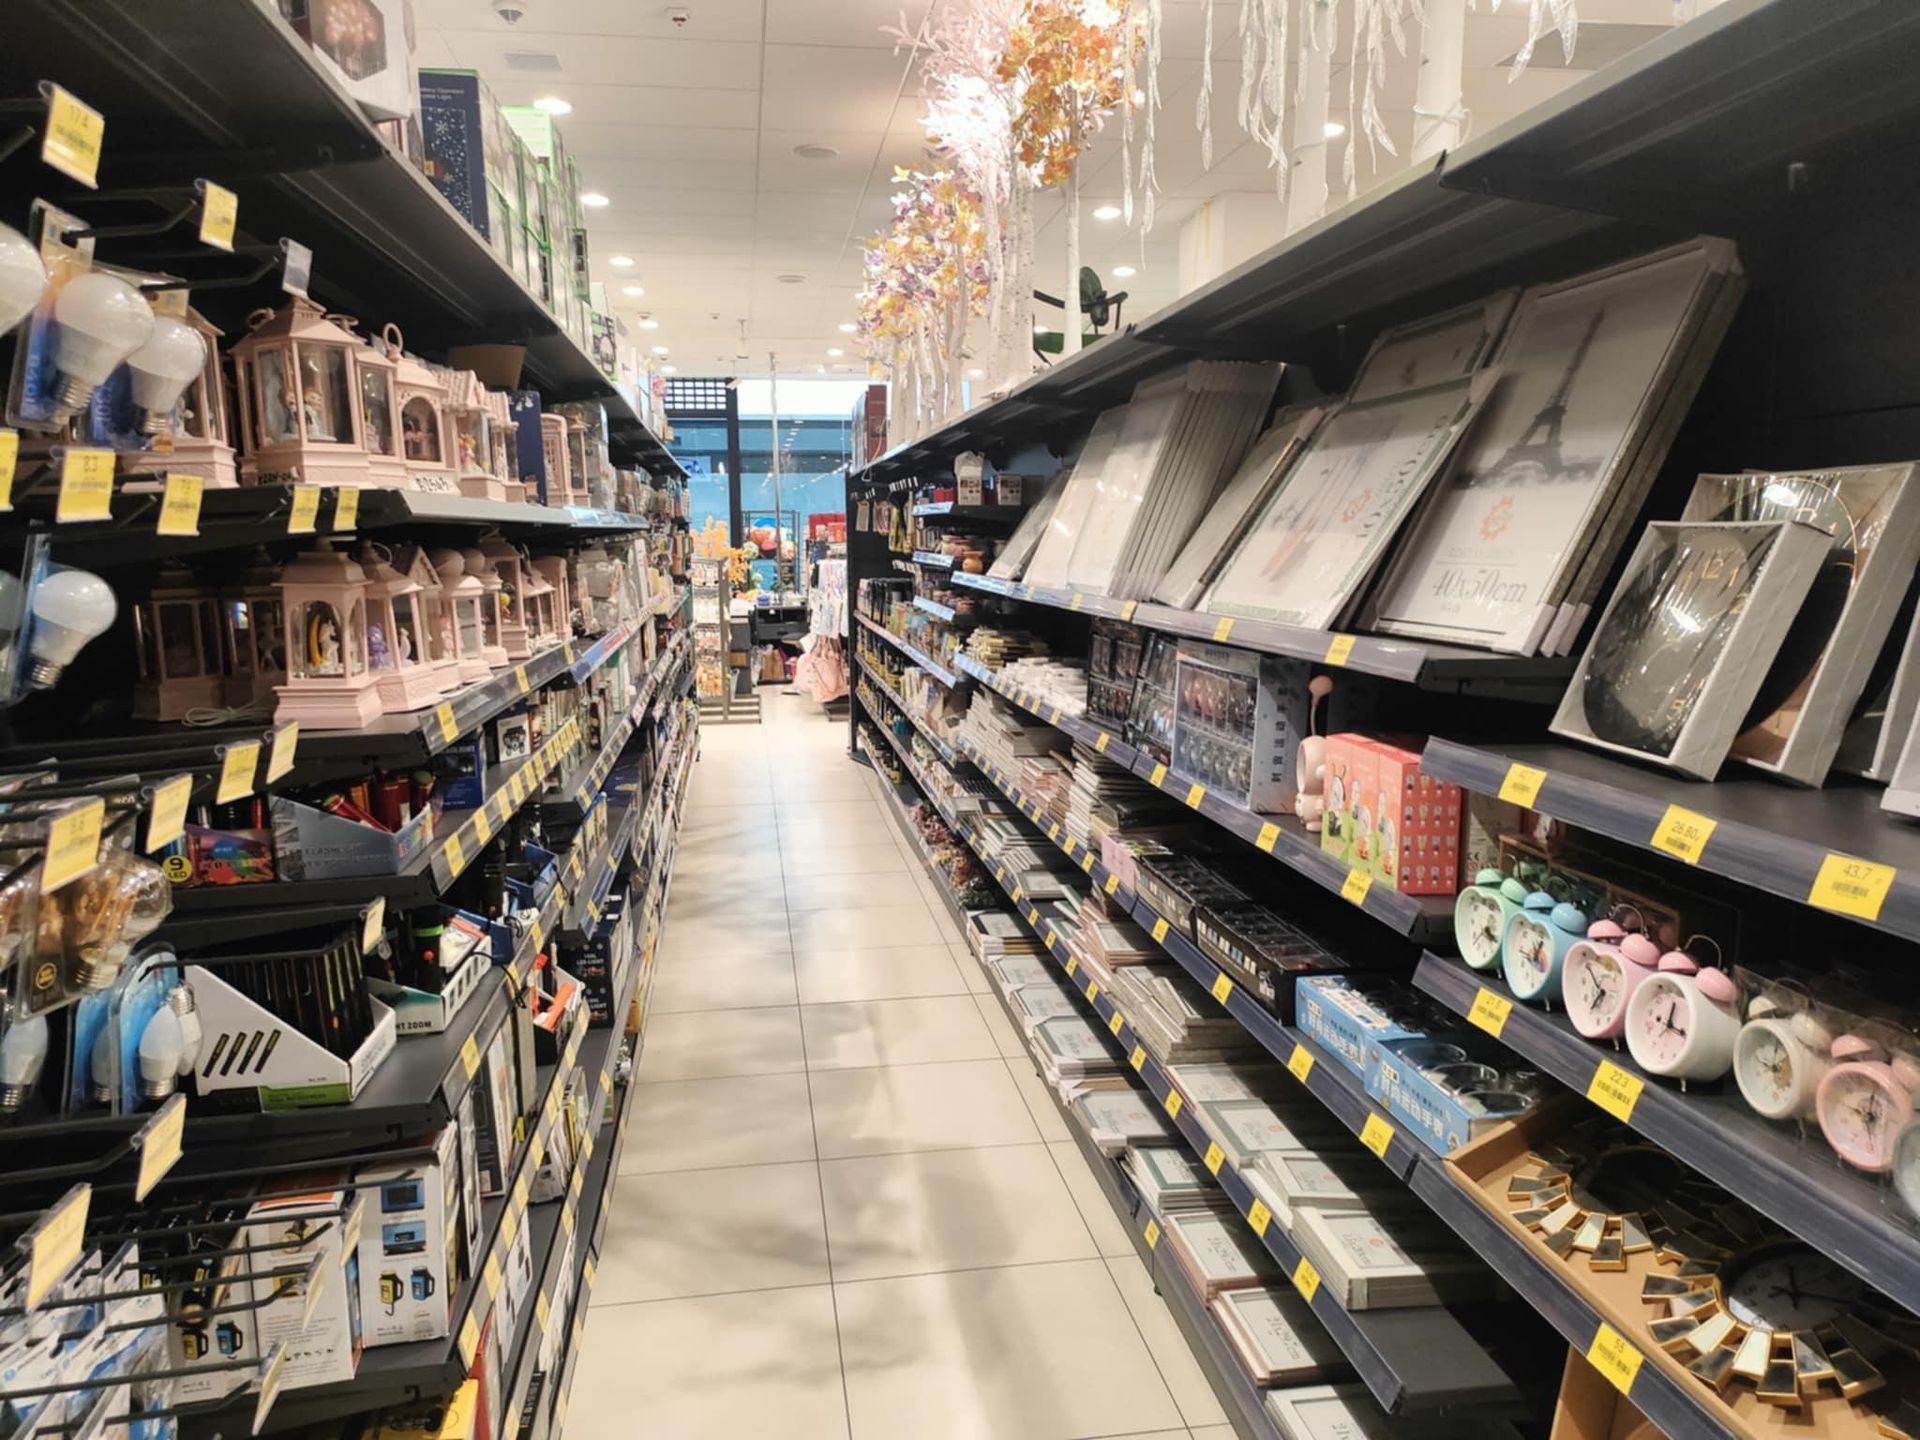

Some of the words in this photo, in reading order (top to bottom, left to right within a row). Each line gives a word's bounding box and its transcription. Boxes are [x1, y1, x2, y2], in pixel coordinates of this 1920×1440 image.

[169, 857, 184, 871] 9
[1843, 864, 1874, 881] 43.7
[408, 1020, 432, 1029] ZOOM
[1610, 1070, 1630, 1089] 22.3
